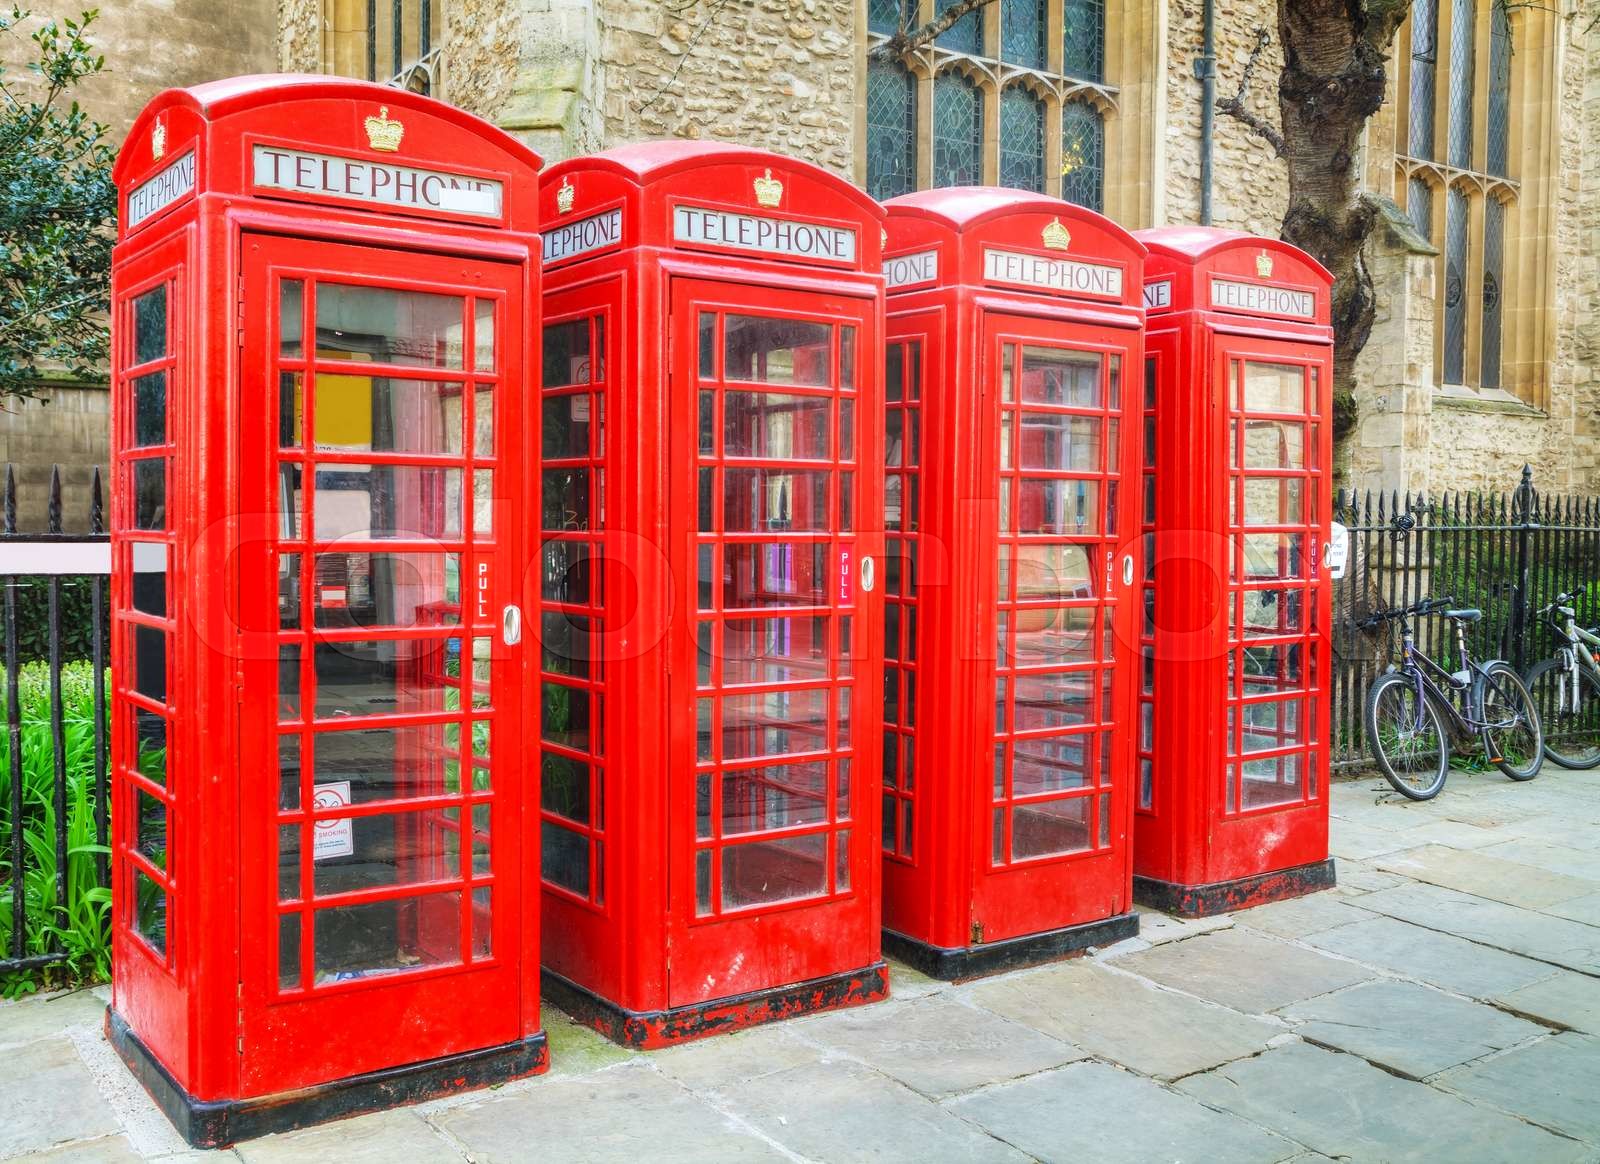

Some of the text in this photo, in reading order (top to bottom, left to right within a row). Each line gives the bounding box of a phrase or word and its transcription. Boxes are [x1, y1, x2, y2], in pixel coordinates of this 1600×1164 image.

[132, 154, 195, 225] TELEPHONE
[263, 152, 493, 207] TELEPHO
[679, 211, 847, 258] TELEPHONE
[988, 253, 1118, 294] TELEPHONE
[1214, 283, 1310, 316] TELEPHONE
[478, 563, 488, 617] PULL
[841, 552, 849, 599] PULL
